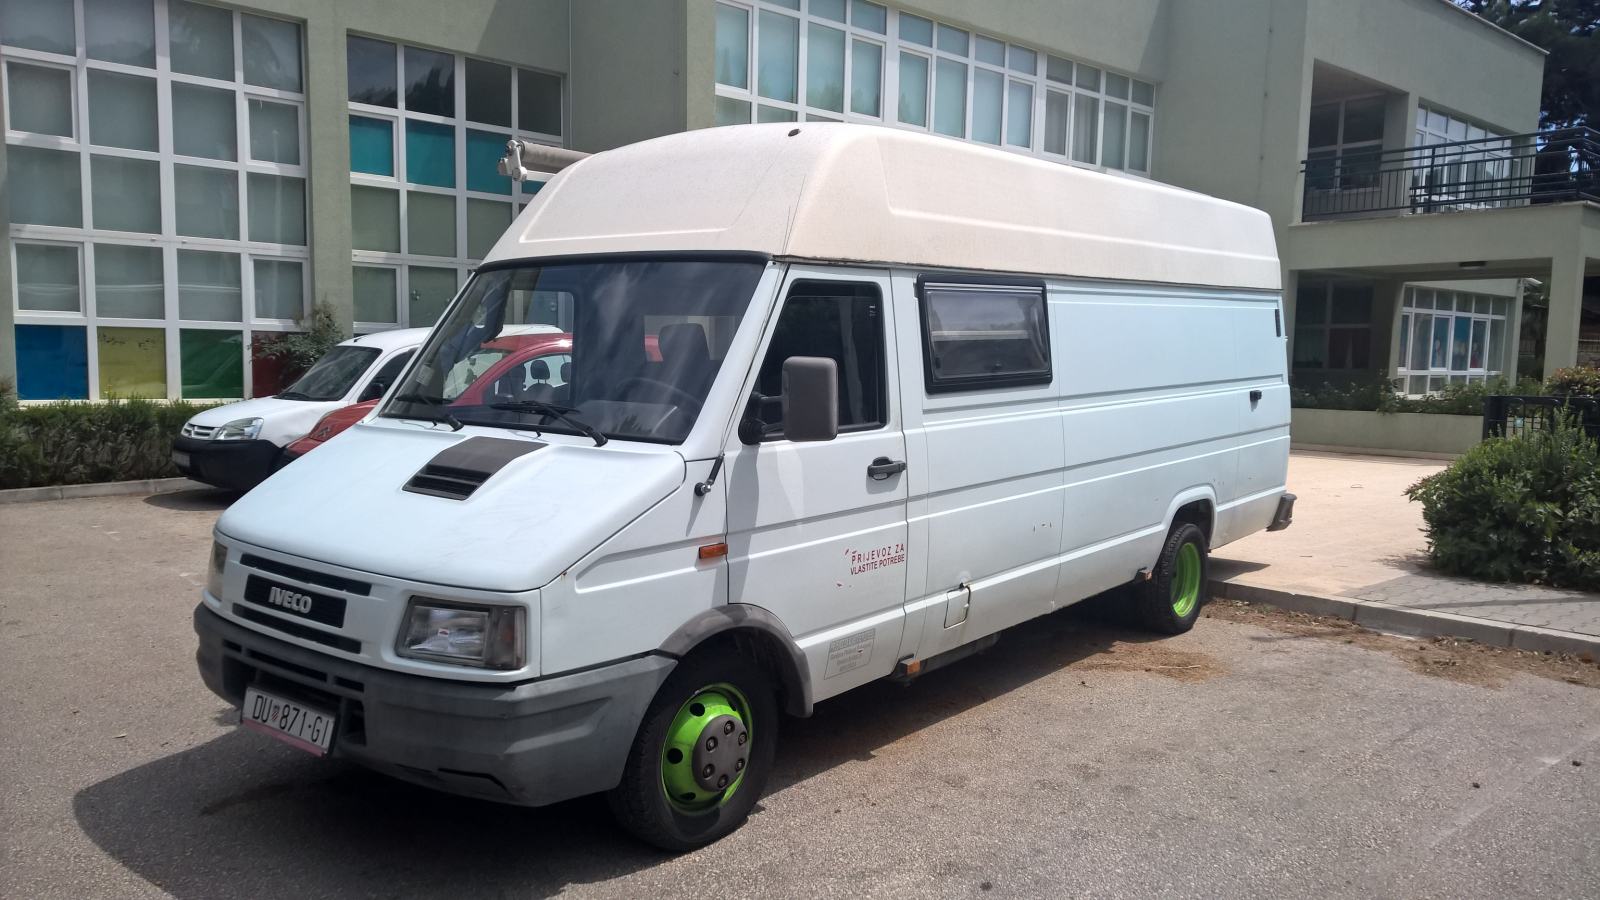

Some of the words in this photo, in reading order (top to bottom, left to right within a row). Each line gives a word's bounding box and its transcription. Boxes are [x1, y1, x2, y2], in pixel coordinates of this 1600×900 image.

[850, 560, 878, 575] VLASTITE
[879, 553, 905, 567] POTREBE
[851, 546, 891, 565] PRIJEVOZ
[895, 543, 905, 554] ZA
[268, 586, 312, 614] IVECO
[252, 695, 273, 723] DU
